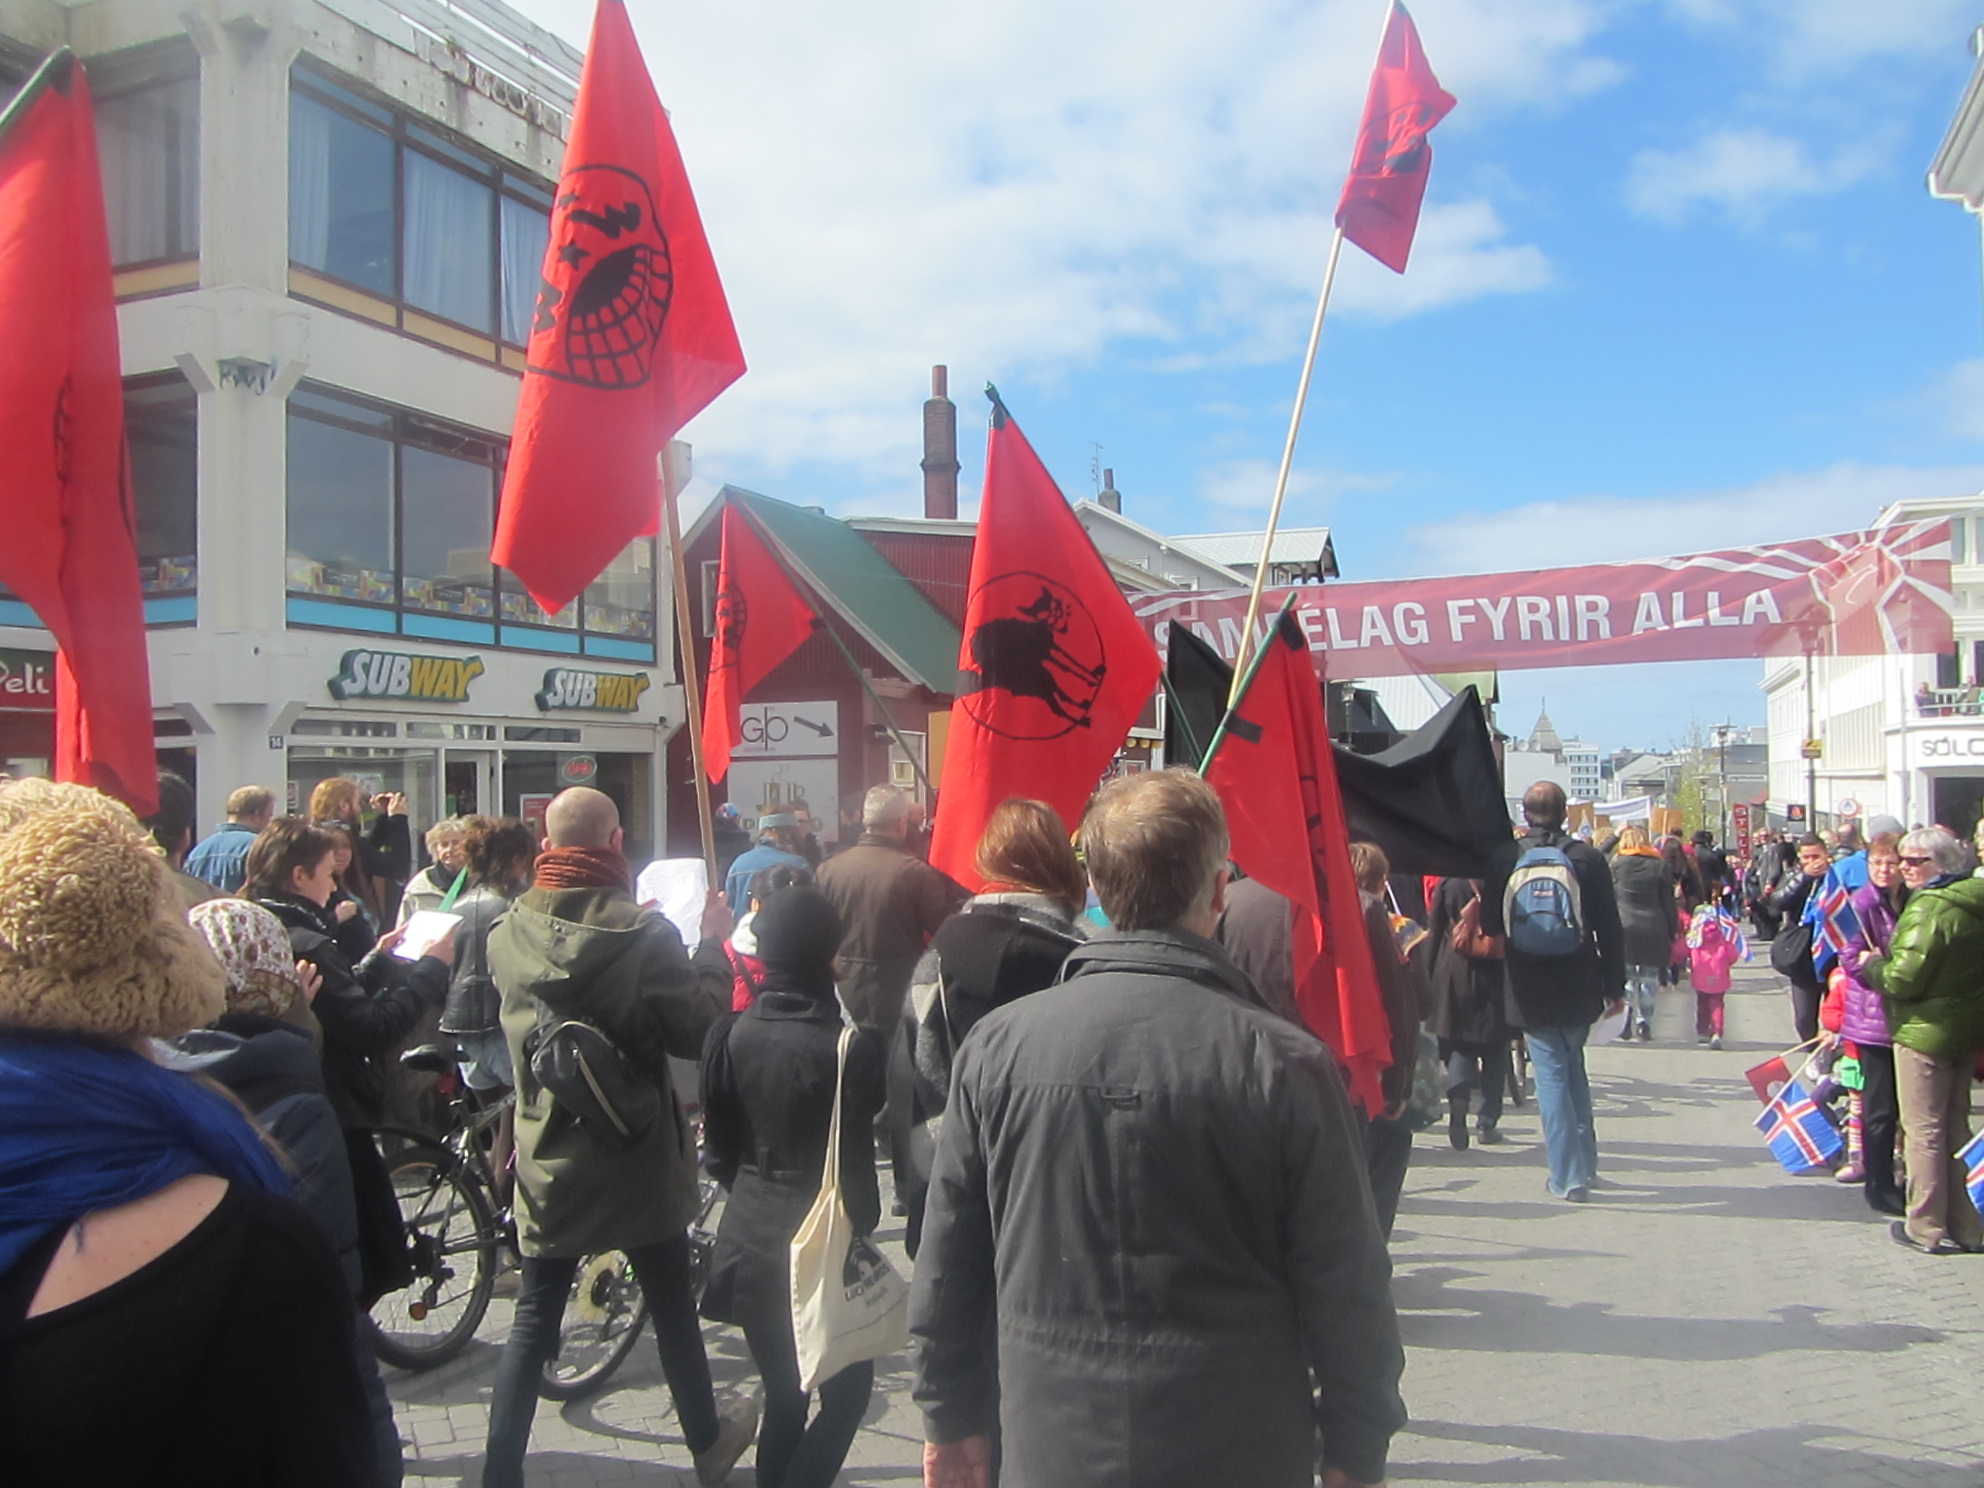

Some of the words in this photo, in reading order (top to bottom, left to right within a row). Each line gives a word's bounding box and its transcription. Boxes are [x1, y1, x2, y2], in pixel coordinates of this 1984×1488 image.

[1154, 602, 1430, 663] SAMÉLAG
[1446, 594, 1612, 642] FYRIR
[1632, 588, 1782, 637] ALLA
[341, 651, 483, 699] SUBWAY
[546, 669, 650, 710] SUBWAY
